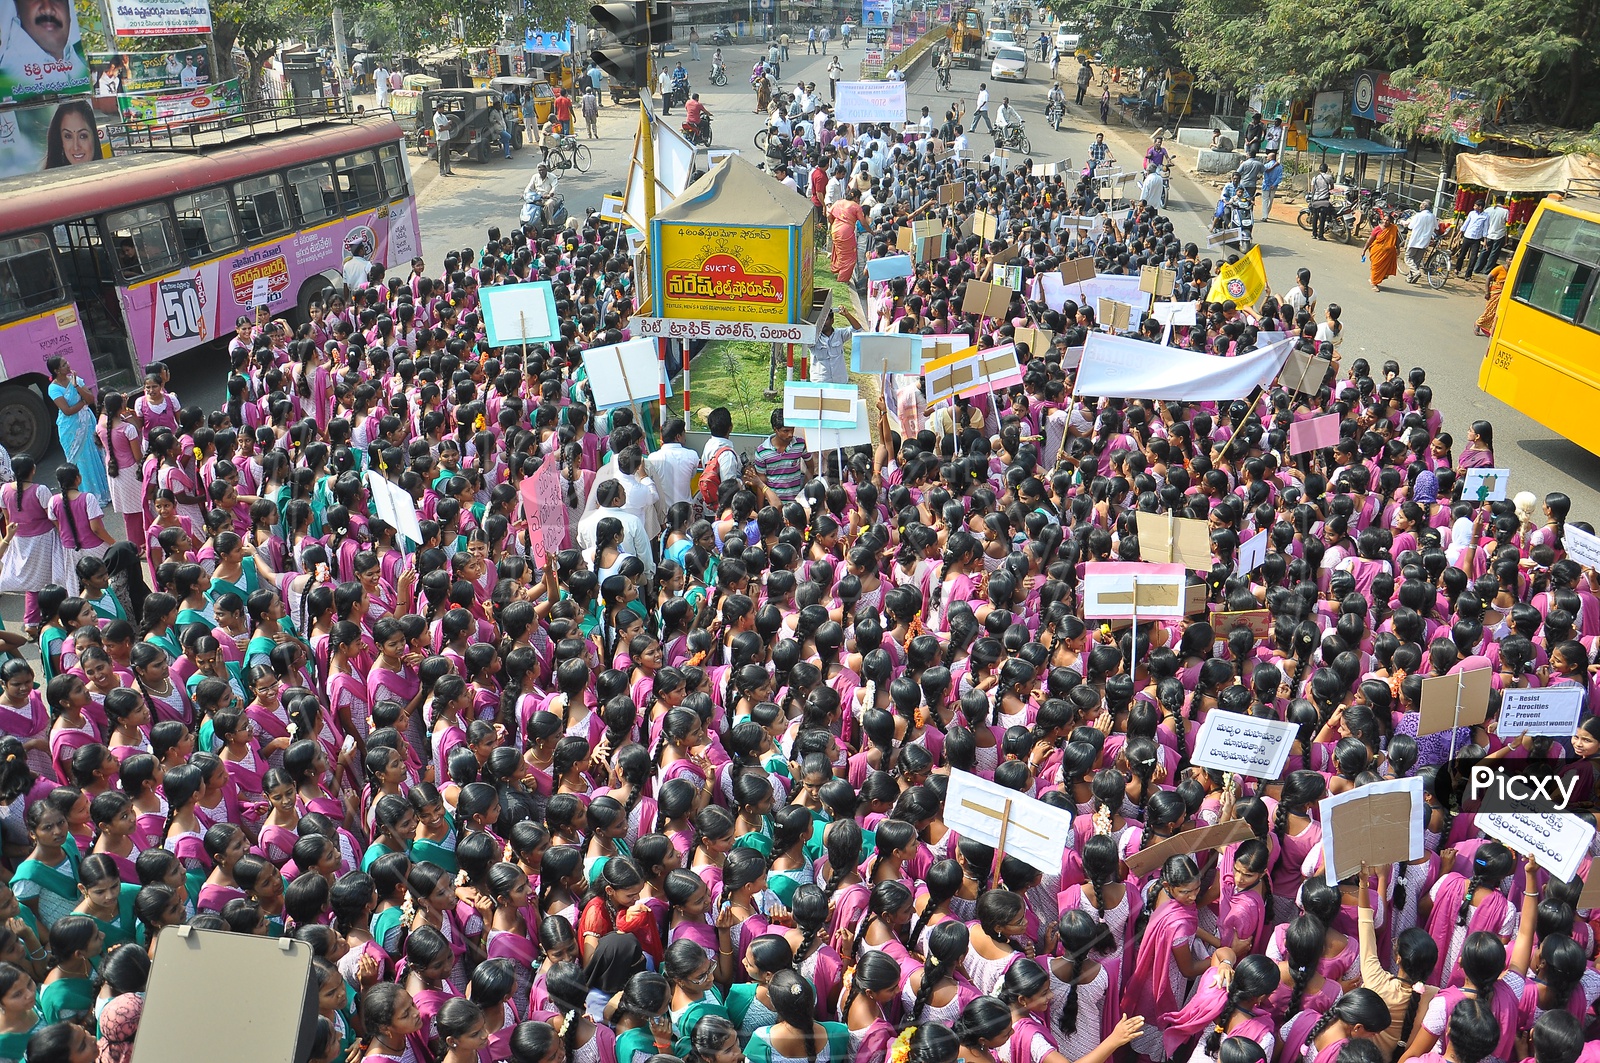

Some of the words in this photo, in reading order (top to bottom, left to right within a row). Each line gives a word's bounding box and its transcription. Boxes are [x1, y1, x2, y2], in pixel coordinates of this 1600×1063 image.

[24, 63, 44, 80] కత్తి
[678, 228, 684, 236] 4
[232, 251, 261, 268] షాపింగ్
[262, 245, 282, 259] మాల్
[233, 266, 260, 287] చందన
[261, 258, 287, 278] బ్రదర్స్
[705, 264, 736, 273] SVKT'S
[669, 273, 715, 297] నరేష్
[669, 321, 711, 337] ట్రాఫిక్
[760, 326, 802, 341] ఏలూరు
[1216, 723, 1241, 737] మద్యం
[1243, 728, 1283, 746] మహమ్మారి
[1223, 737, 1266, 755] మానవత్వాన్ని
[1511, 811, 1551, 838] సమాజం
[1487, 810, 1564, 863] రక్షించబడుతుంది
